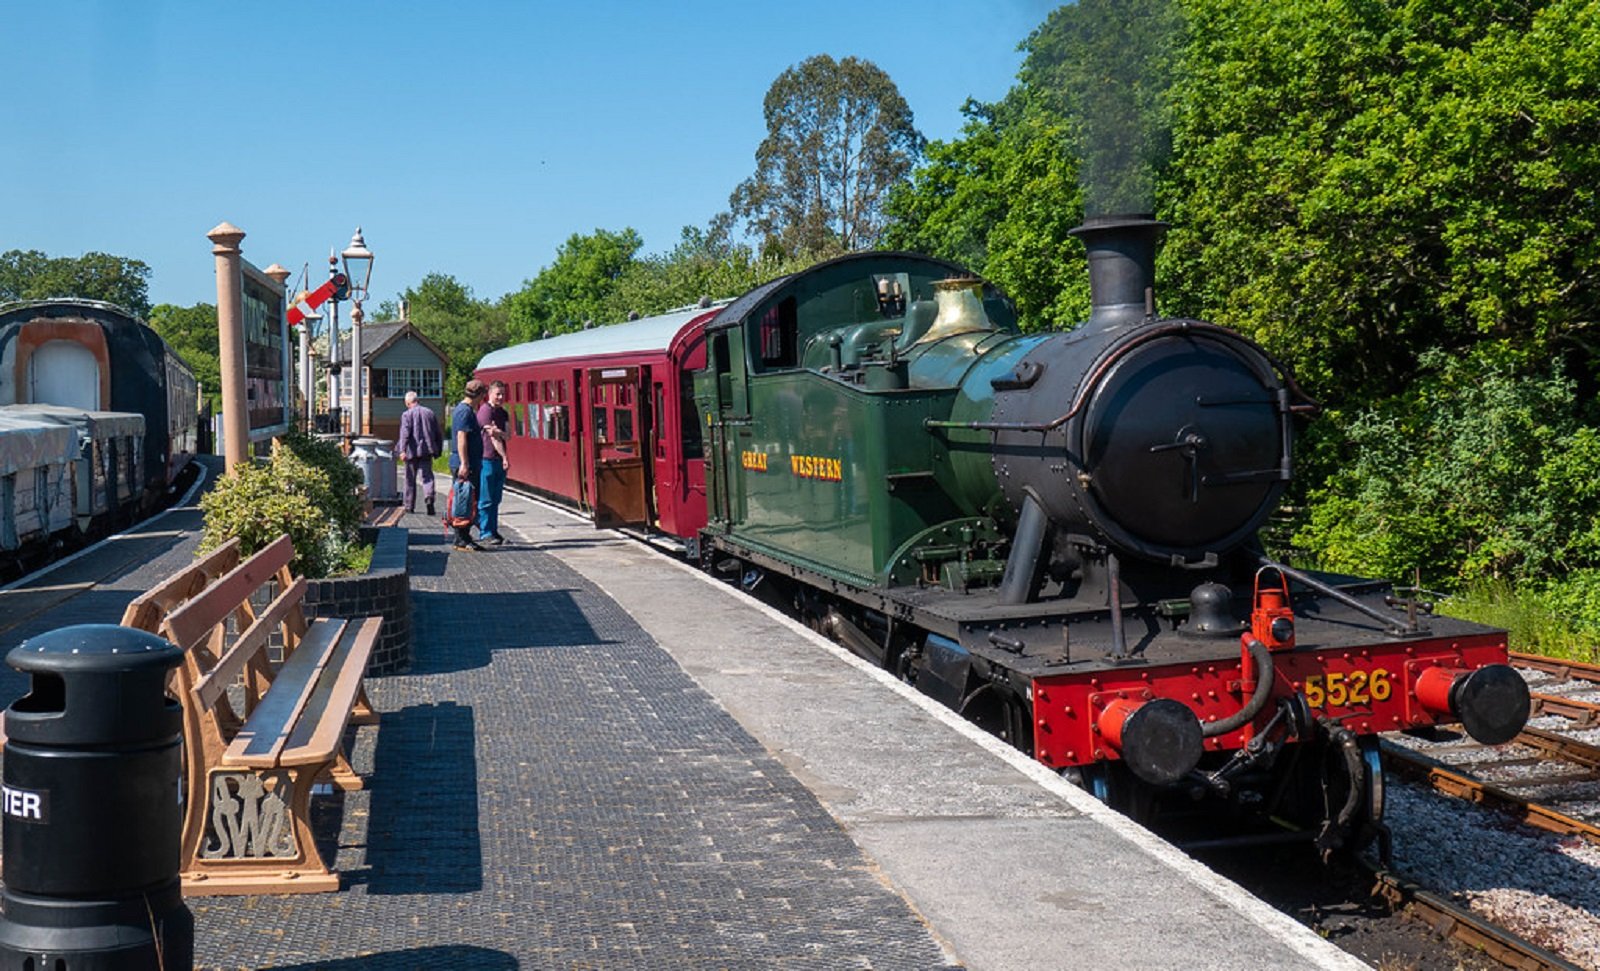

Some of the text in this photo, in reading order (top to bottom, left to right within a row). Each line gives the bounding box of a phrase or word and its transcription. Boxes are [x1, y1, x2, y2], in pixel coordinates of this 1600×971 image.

[742, 451, 842, 482] GREAT WESTERN
[1305, 668, 1391, 708] 5526
